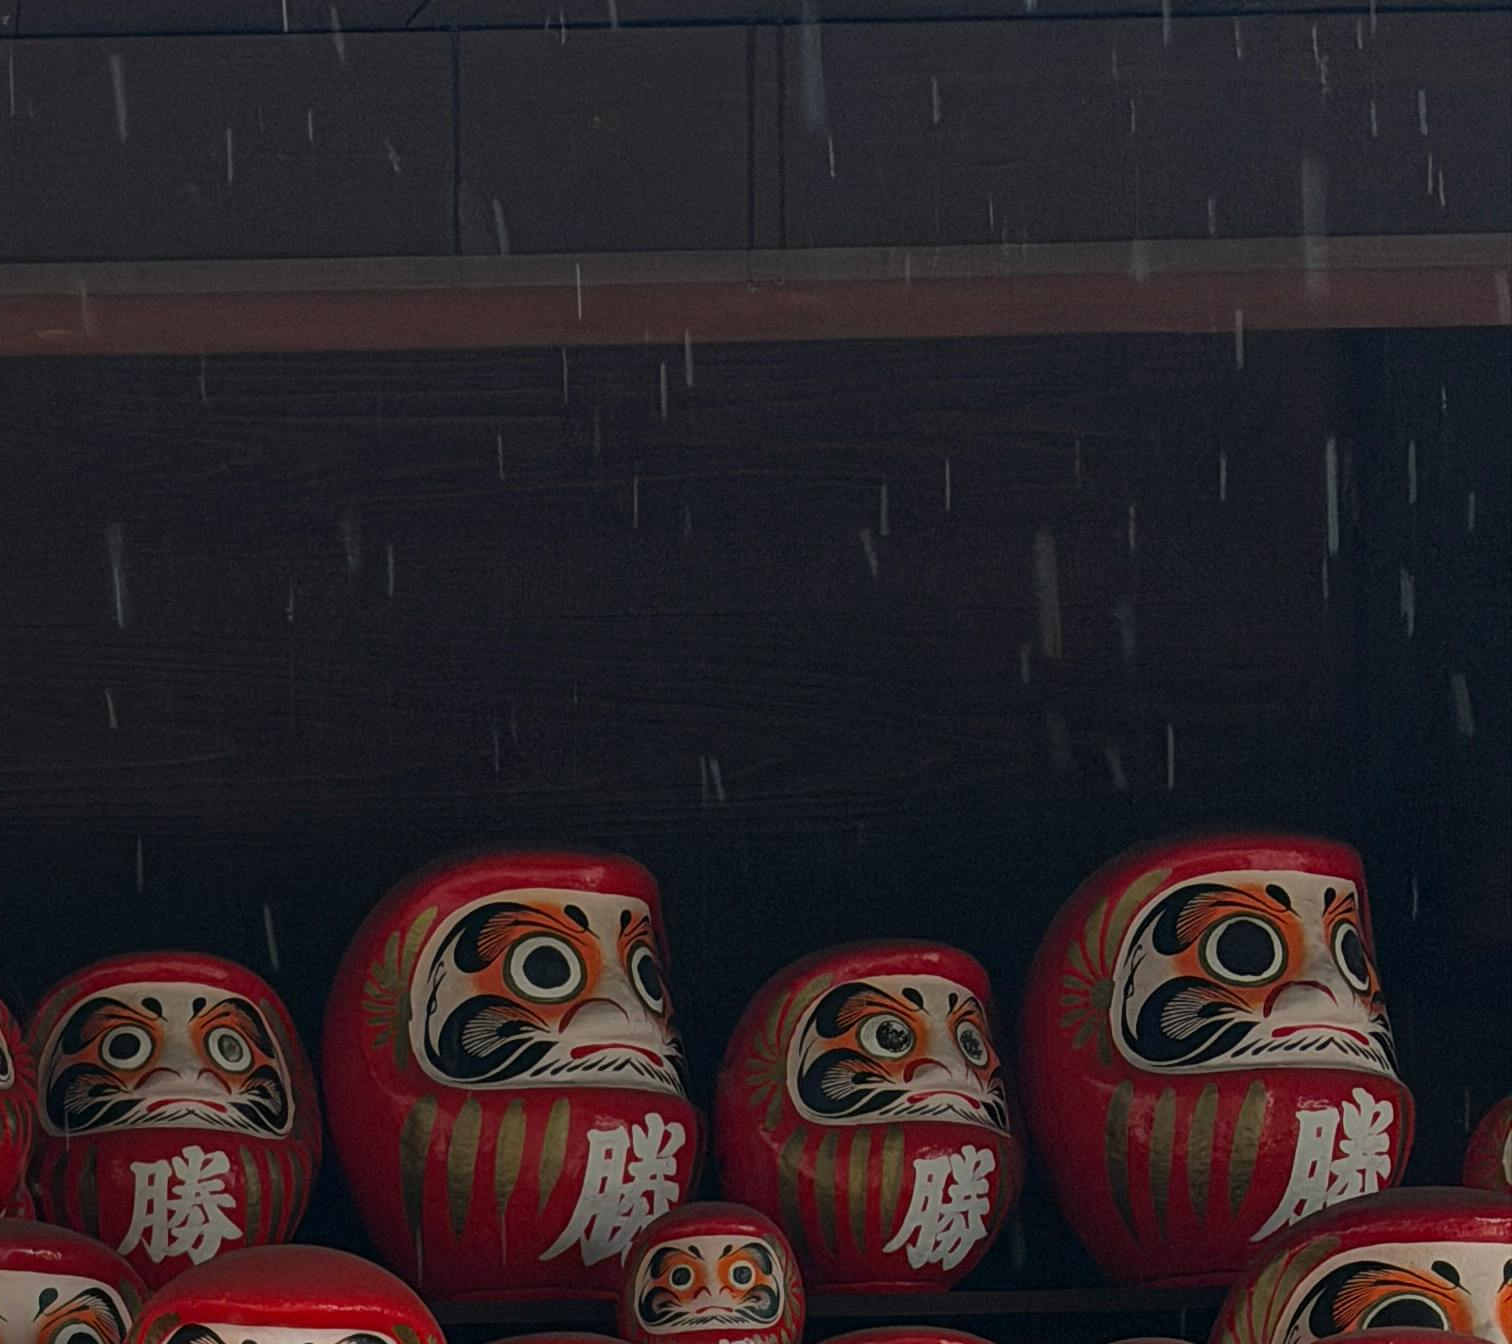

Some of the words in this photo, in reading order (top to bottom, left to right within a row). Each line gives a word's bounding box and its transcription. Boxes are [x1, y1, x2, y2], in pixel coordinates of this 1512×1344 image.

[118, 1145, 244, 1266] 勝
[540, 1112, 686, 1267] 勝
[882, 1144, 996, 1271] 勝
[1251, 1087, 1394, 1243] 勝
